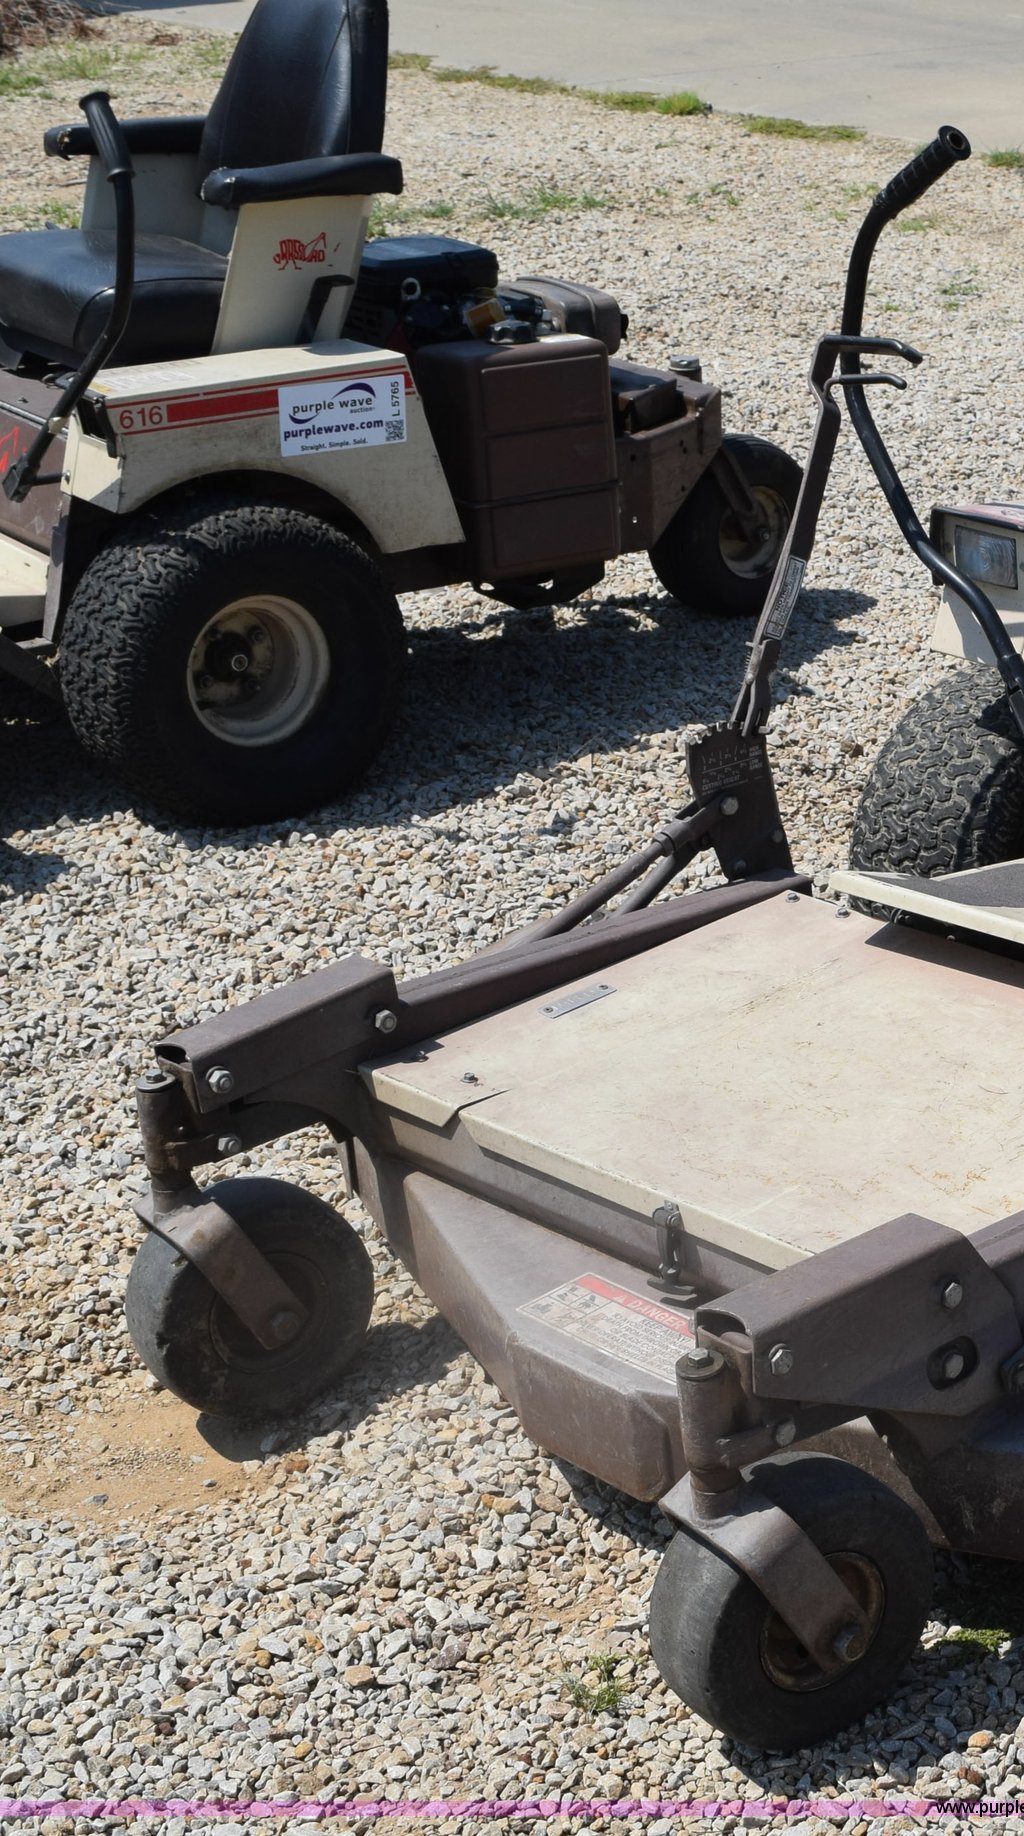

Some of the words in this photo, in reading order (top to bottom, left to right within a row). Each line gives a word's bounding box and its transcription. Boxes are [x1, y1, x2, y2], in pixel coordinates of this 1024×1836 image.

[390, 381, 400, 408] 5765
[119, 405, 164, 429] 616
[292, 400, 334, 416] purple
[338, 397, 373, 409] wave
[283, 419, 384, 441] purplewave.com
[300, 443, 327, 452] Straight.
[328, 440, 352, 449] Simple.
[627, 1298, 686, 1330] DANGER
